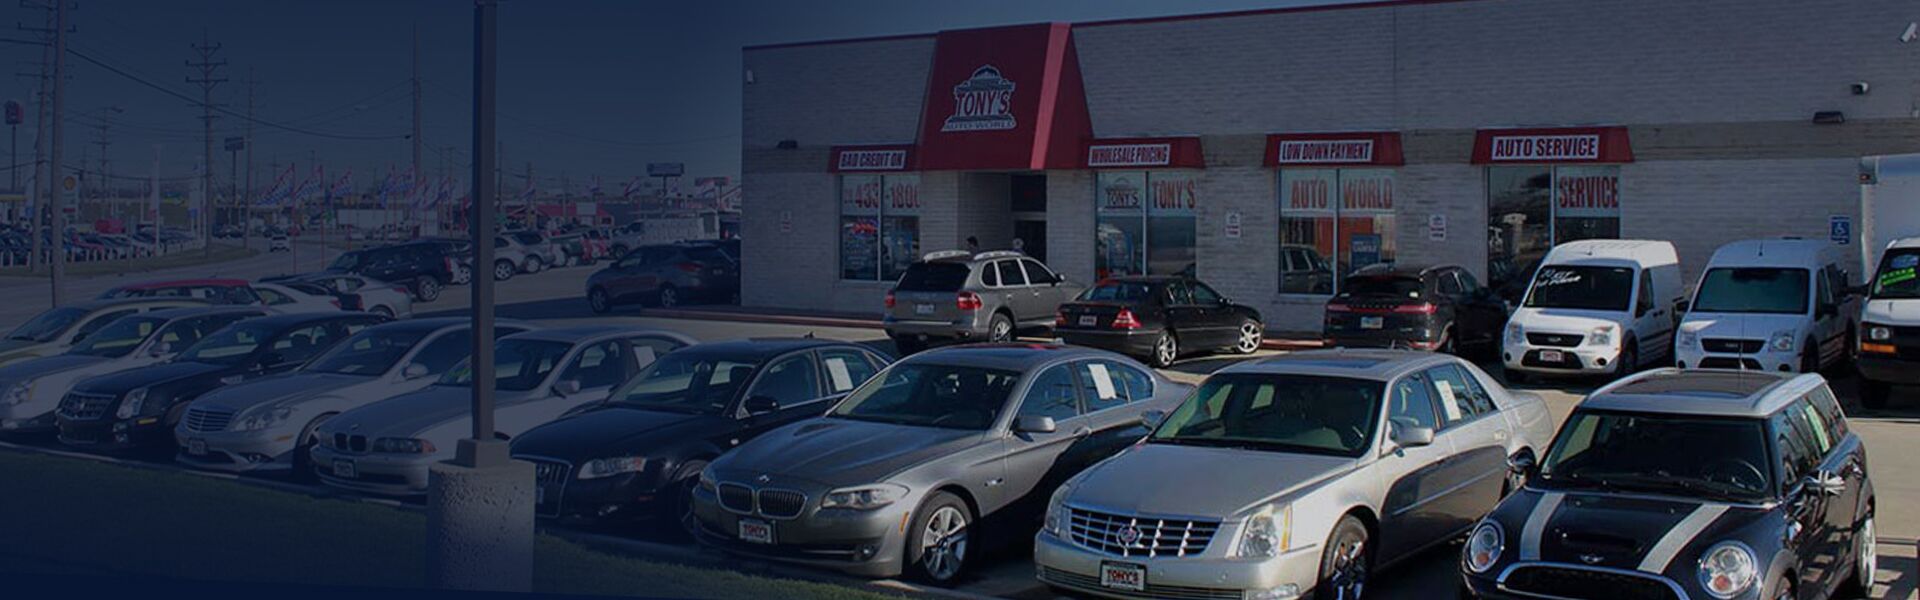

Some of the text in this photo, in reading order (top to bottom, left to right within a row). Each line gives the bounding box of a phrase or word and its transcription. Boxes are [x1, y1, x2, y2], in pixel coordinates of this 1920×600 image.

[955, 88, 1009, 115] TONY'S
[1090, 146, 1168, 164] WHOLESALE PRICING
[1281, 142, 1370, 161] LOW DOWN PAYMENT
[1495, 137, 1596, 157] AUTO SERVICE
[840, 153, 859, 168] BAD
[859, 153, 890, 168] CREDIT
[1152, 180, 1196, 209] TONY'S
[1291, 178, 1393, 209] AUTO WORLD
[1560, 176, 1619, 208] SERVICE
